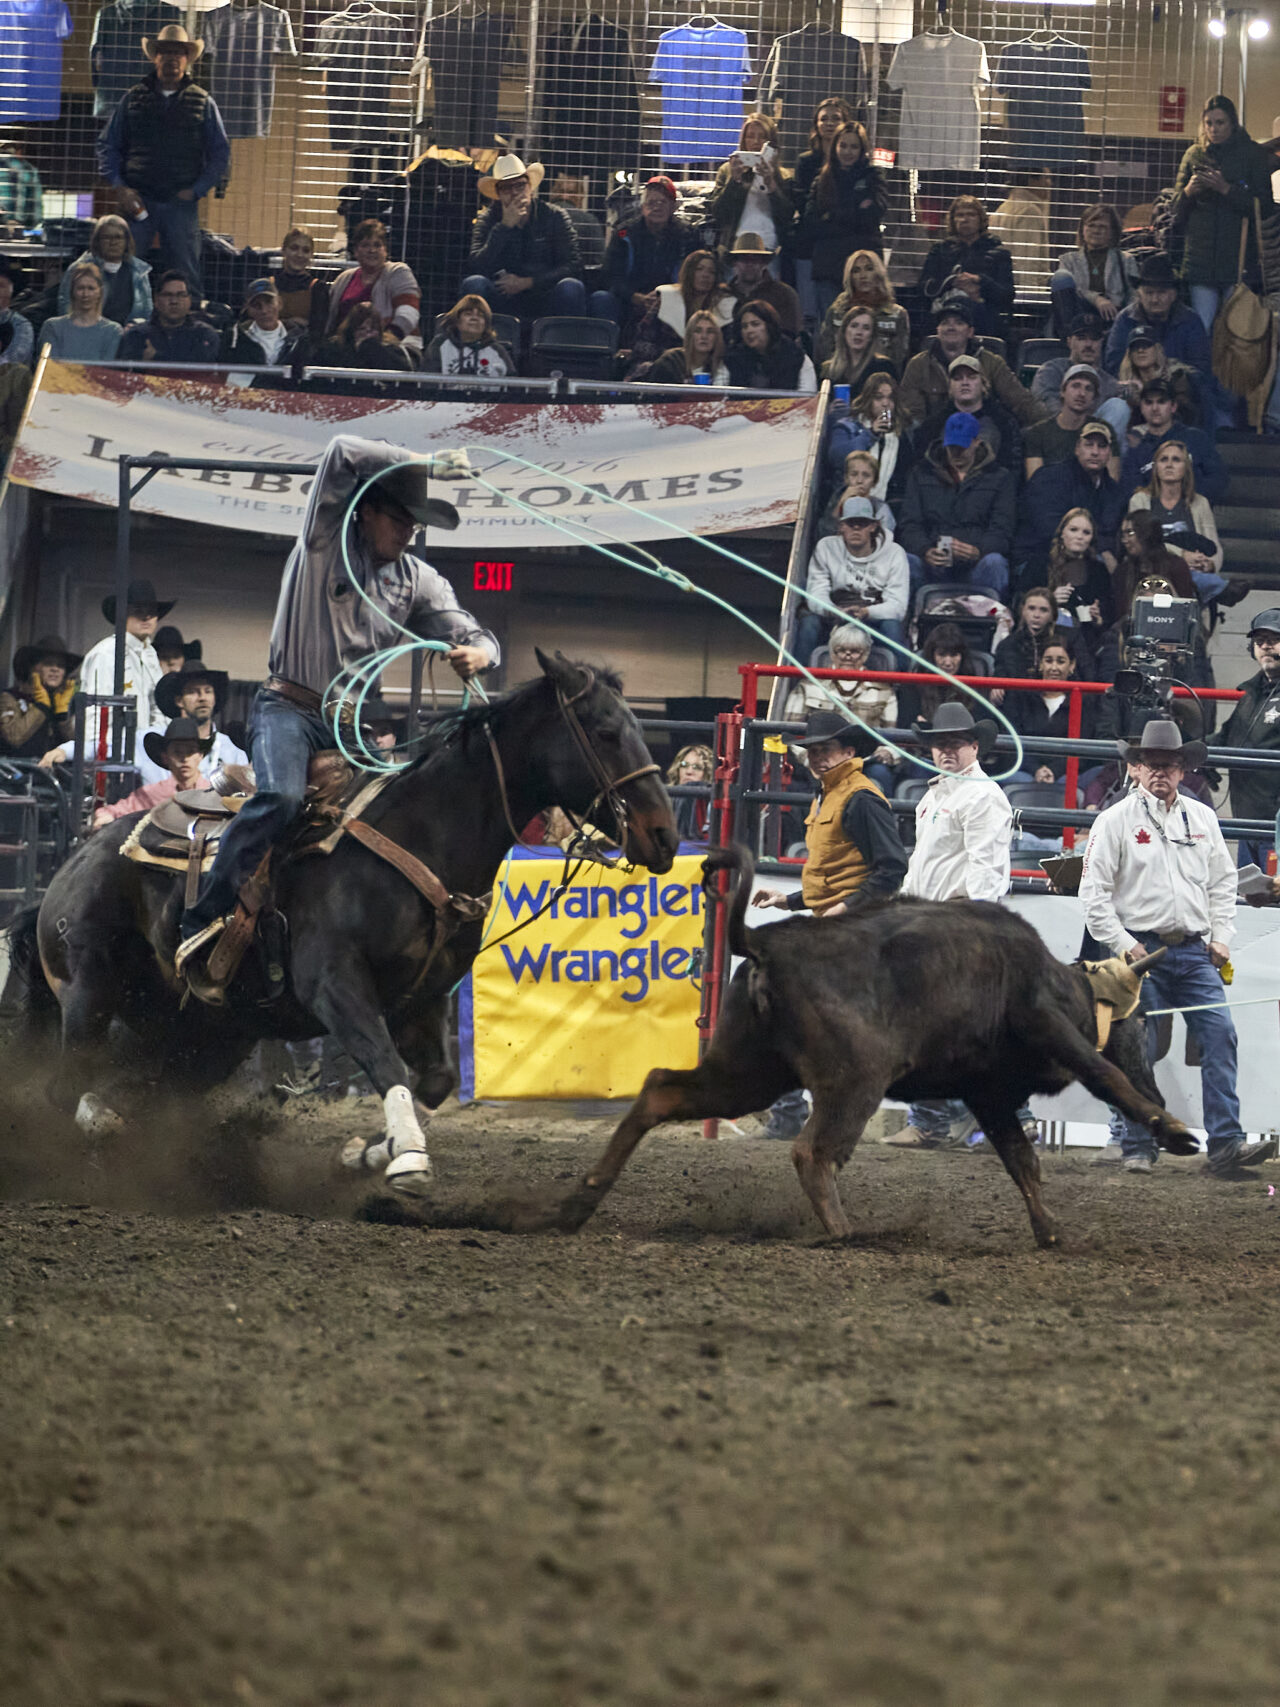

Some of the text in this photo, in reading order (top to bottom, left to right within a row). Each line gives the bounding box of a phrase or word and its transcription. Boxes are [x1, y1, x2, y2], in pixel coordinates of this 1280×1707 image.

[450, 468, 743, 508] HOMES
[217, 494, 268, 512] THE
[473, 562, 514, 591] EXIT
[1147, 616, 1175, 624] SONY
[498, 877, 706, 939] Wrangler
